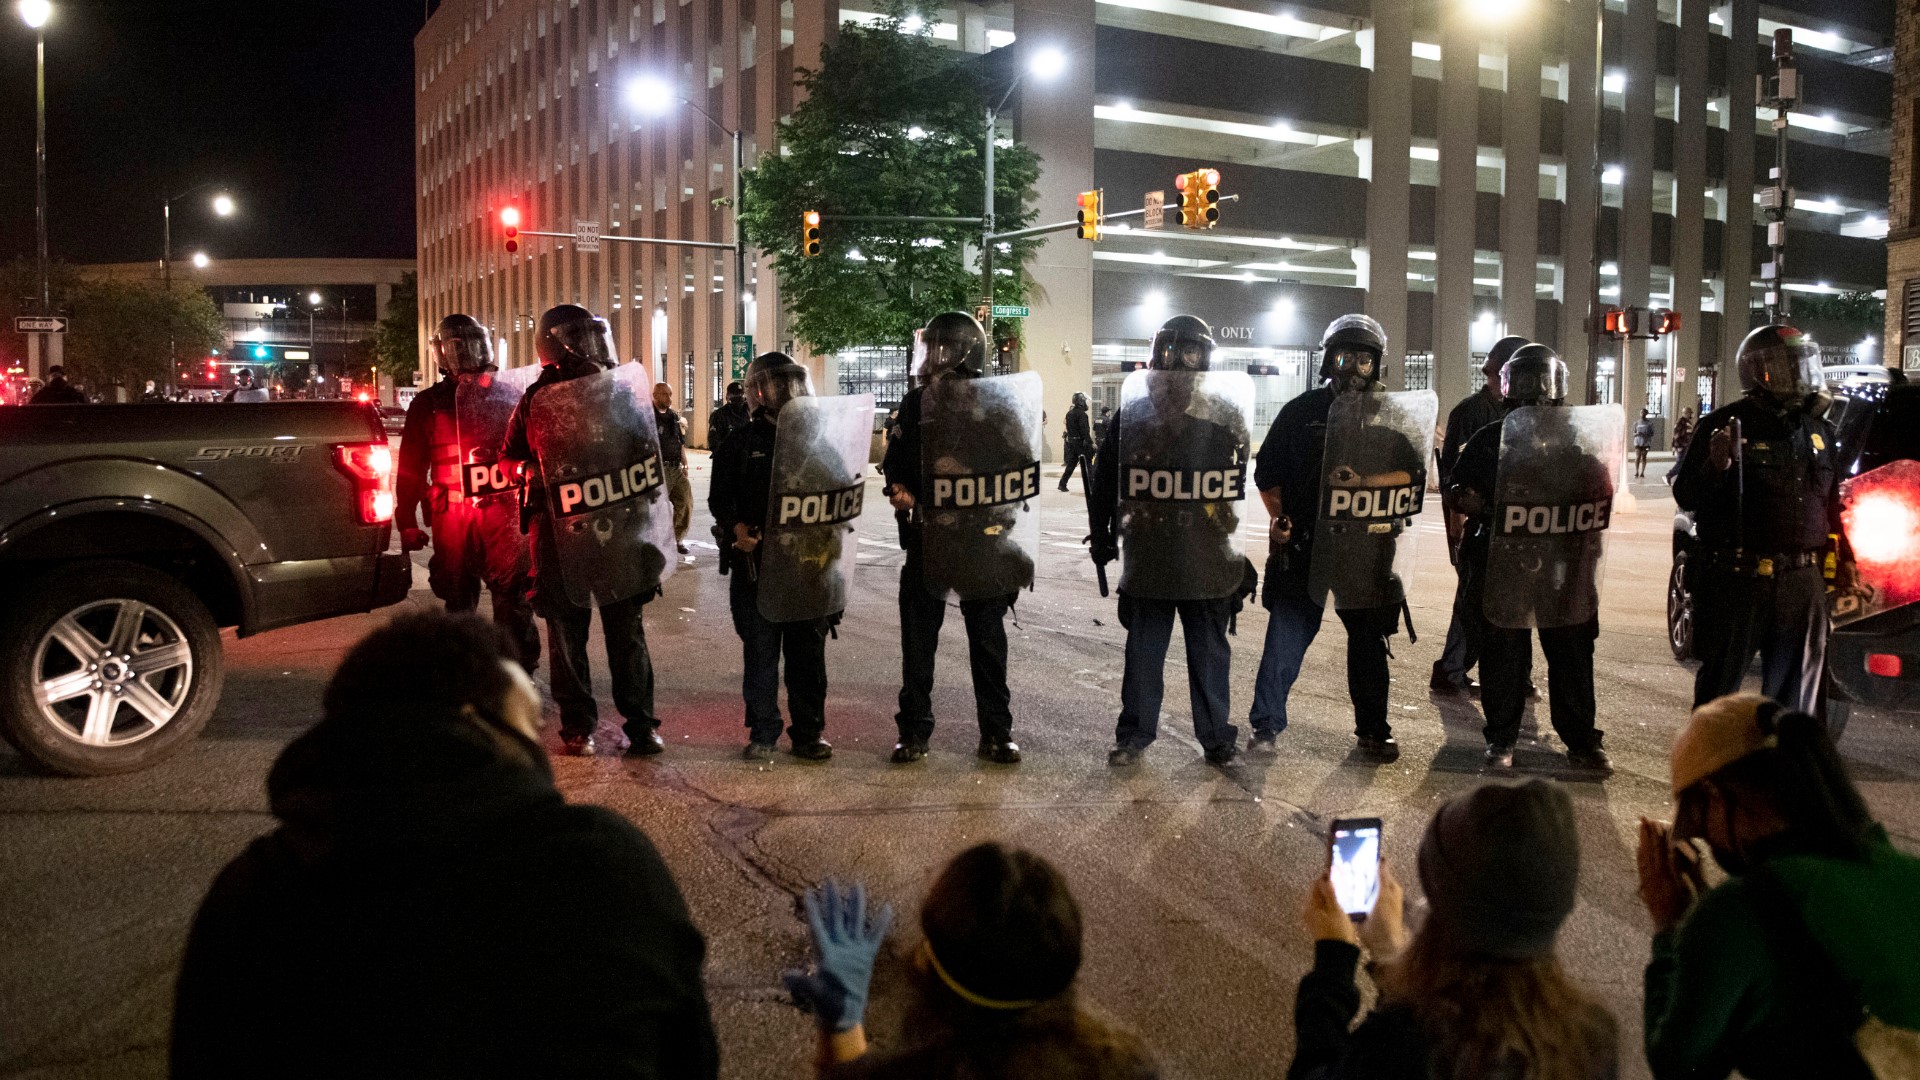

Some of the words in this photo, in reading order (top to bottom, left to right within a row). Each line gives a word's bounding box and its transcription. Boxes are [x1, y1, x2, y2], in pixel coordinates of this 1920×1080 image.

[578, 235, 599, 243] BLOCK
[996, 307, 1021, 316] Congress
[1022, 307, 1027, 315] E
[21, 321, 36, 329] ONE
[1221, 326, 1255, 339] ONLY
[736, 345, 747, 353] 75
[1821, 355, 1841, 364] ANCE
[185, 444, 316, 462] SPORT
[559, 456, 659, 513] POLICE
[934, 466, 1036, 507] POLICE
[1129, 468, 1240, 500] POLICE
[779, 486, 863, 525] POLICE
[1329, 485, 1422, 518] POLICE
[1504, 500, 1608, 534] POLICE
